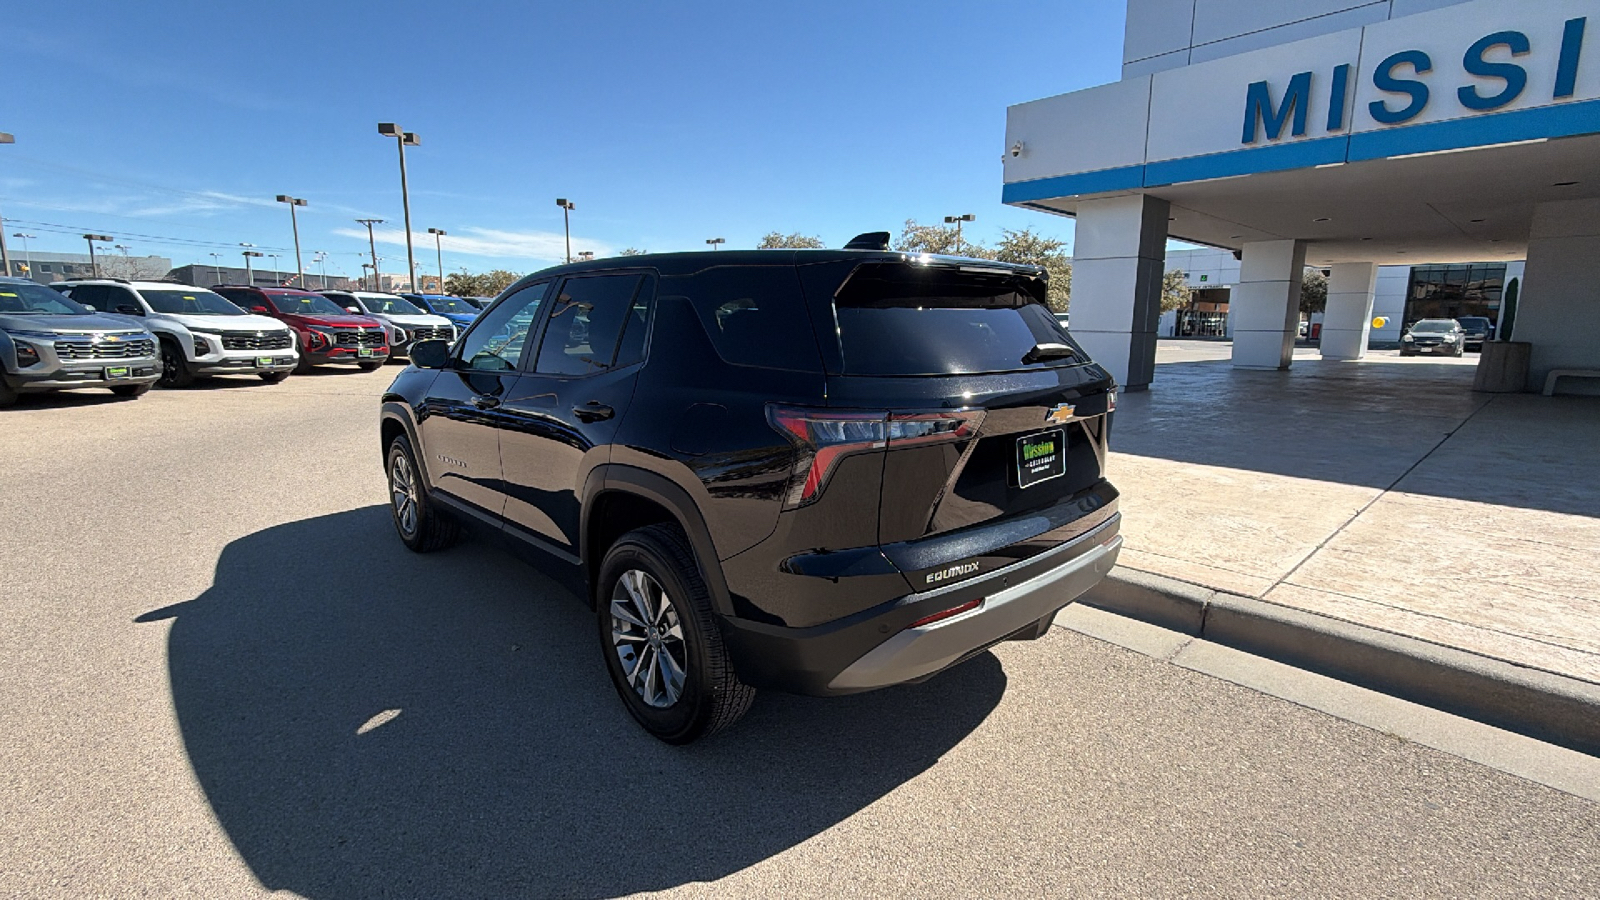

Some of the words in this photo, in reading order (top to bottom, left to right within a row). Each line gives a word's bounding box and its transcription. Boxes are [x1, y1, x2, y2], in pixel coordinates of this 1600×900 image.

[1242, 17, 1587, 144] MISSI
[1023, 441, 1054, 460] Mission
[926, 561, 979, 584] EQUINOX
